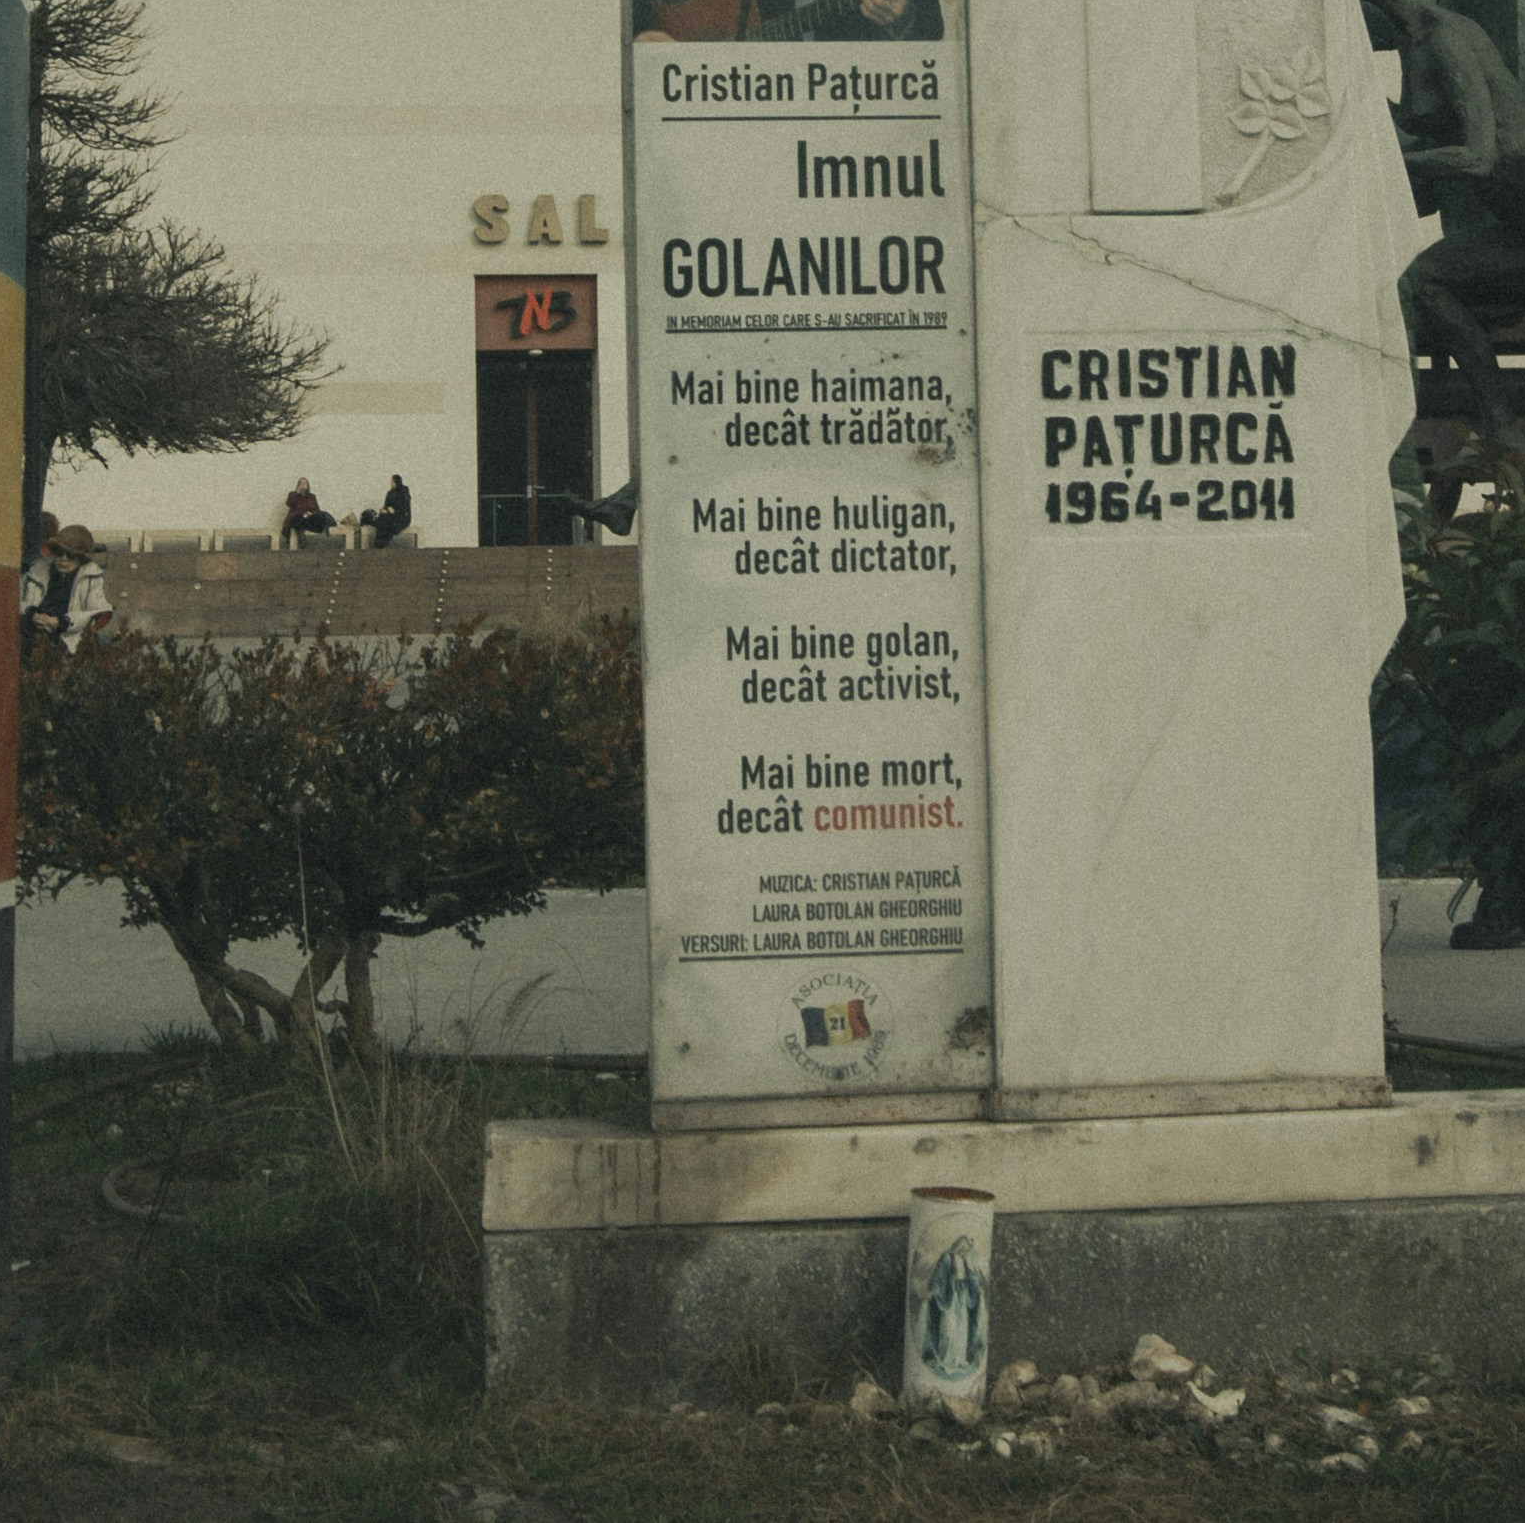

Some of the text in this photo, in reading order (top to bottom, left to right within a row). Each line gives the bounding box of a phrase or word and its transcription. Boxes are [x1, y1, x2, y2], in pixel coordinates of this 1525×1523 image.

[663, 59, 939, 115] Cristian Pațurcă
[797, 139, 945, 198] Imnul
[663, 236, 946, 297] GOLANILOR
[681, 315, 741, 328] MEMORIAM
[745, 314, 779, 327] CELOR
[783, 314, 810, 327] CARE
[814, 313, 841, 326] S-AU
[845, 312, 905, 326] SACRIFICAT
[908, 309, 920, 325] ÎN
[923, 312, 948, 325] 1989
[671, 368, 953, 405] Mai bine haimana,
[1041, 343, 1296, 400] CRISTIAN
[725, 407, 954, 448] decât trădător,
[693, 495, 955, 538] Mai bine huligan,
[1045, 477, 1295, 524] 1964-2011
[735, 536, 956, 577] decât dictator,
[726, 623, 959, 666] Mai bine golan,
[742, 665, 960, 706] decât activist,
[741, 752, 963, 791] Mai bine mort,
[718, 794, 964, 834] decât comunist.
[759, 865, 962, 894] MUZICA: CRISTIAN PAȚURCĂ
[753, 898, 963, 922] LAURA BOTOLAN GHEORGHIU
[681, 927, 963, 953] VERSURI: LAURA BOTOLAN GHEORGHIU
[829, 1016, 845, 1031] 21
